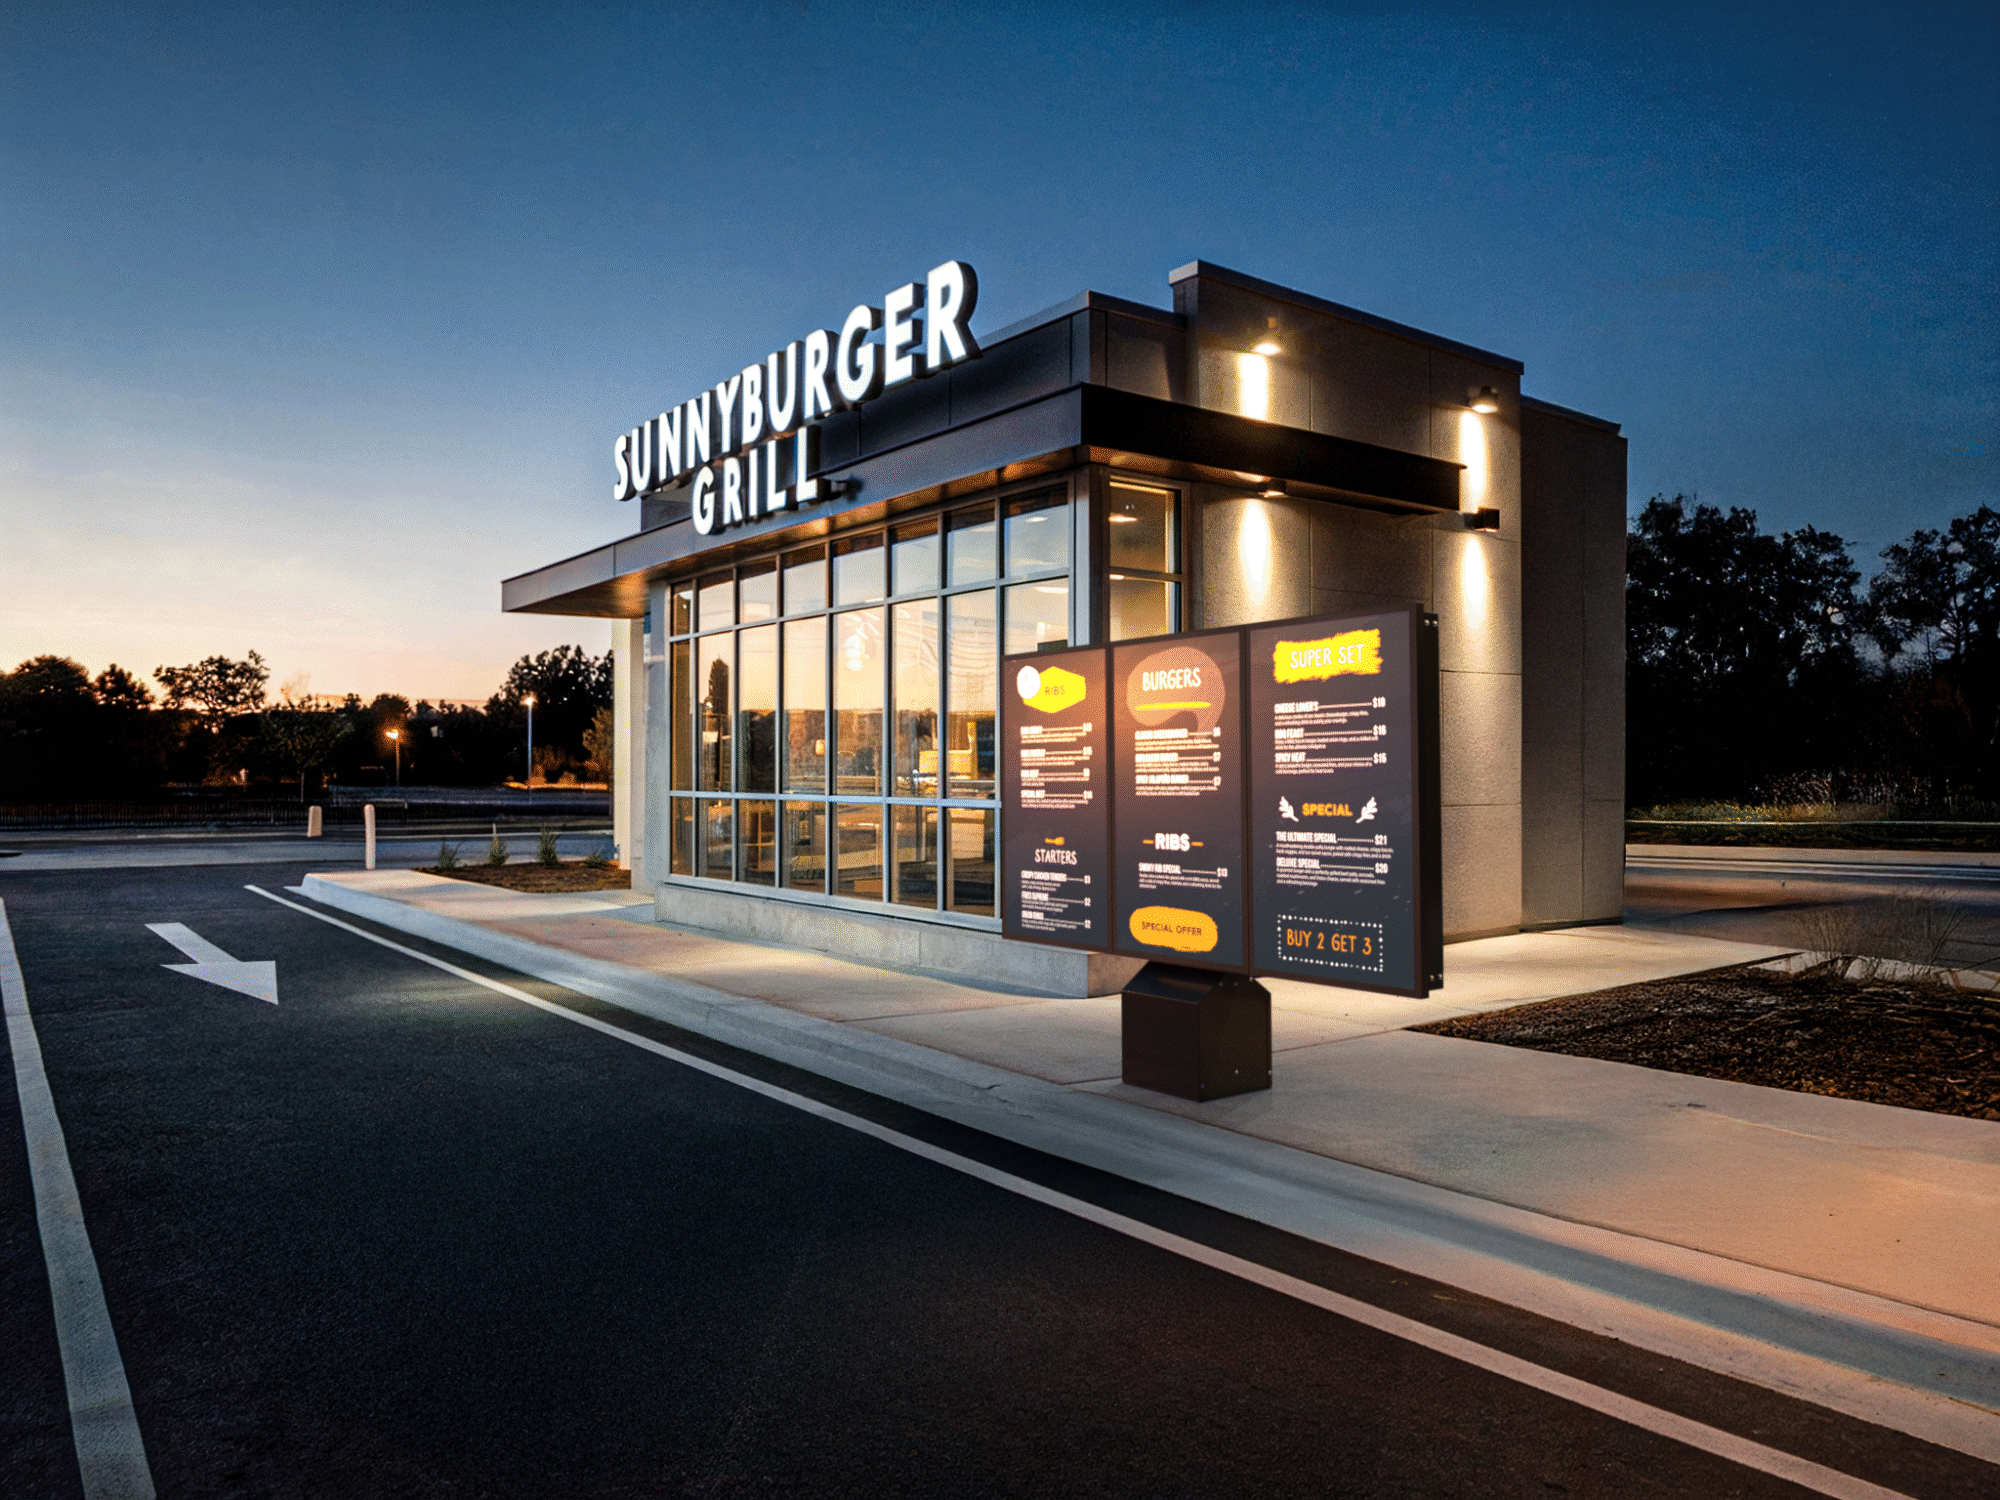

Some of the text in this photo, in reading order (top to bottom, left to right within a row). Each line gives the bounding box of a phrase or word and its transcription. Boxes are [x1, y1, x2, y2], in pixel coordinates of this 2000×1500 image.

[613, 260, 970, 501] SUNNYBURGER
[692, 426, 819, 535] GRILL
[1290, 644, 1365, 669] SUPER SET
[1142, 668, 1202, 692] BURGERS
[1044, 685, 1066, 696] RIBS
[1274, 703, 1295, 713] CHEESE
[1287, 728, 1304, 738] FEAST
[1275, 753, 1291, 762] SPICY
[1291, 752, 1306, 762] HEAT
[1302, 802, 1353, 817] SPECIAL
[1154, 832, 1190, 852] RIBS
[1276, 831, 1387, 845] THE ULTIMATE SPECIAL $21
[1034, 848, 1078, 866] STARTERS
[1276, 857, 1297, 867] DELUXE
[1298, 858, 1320, 869] SPECIAL
[1163, 864, 1181, 874] SPECIAL
[1142, 921, 1202, 936] SPECIAL OFFER
[1286, 928, 1372, 956] BUY 2 GET 3
